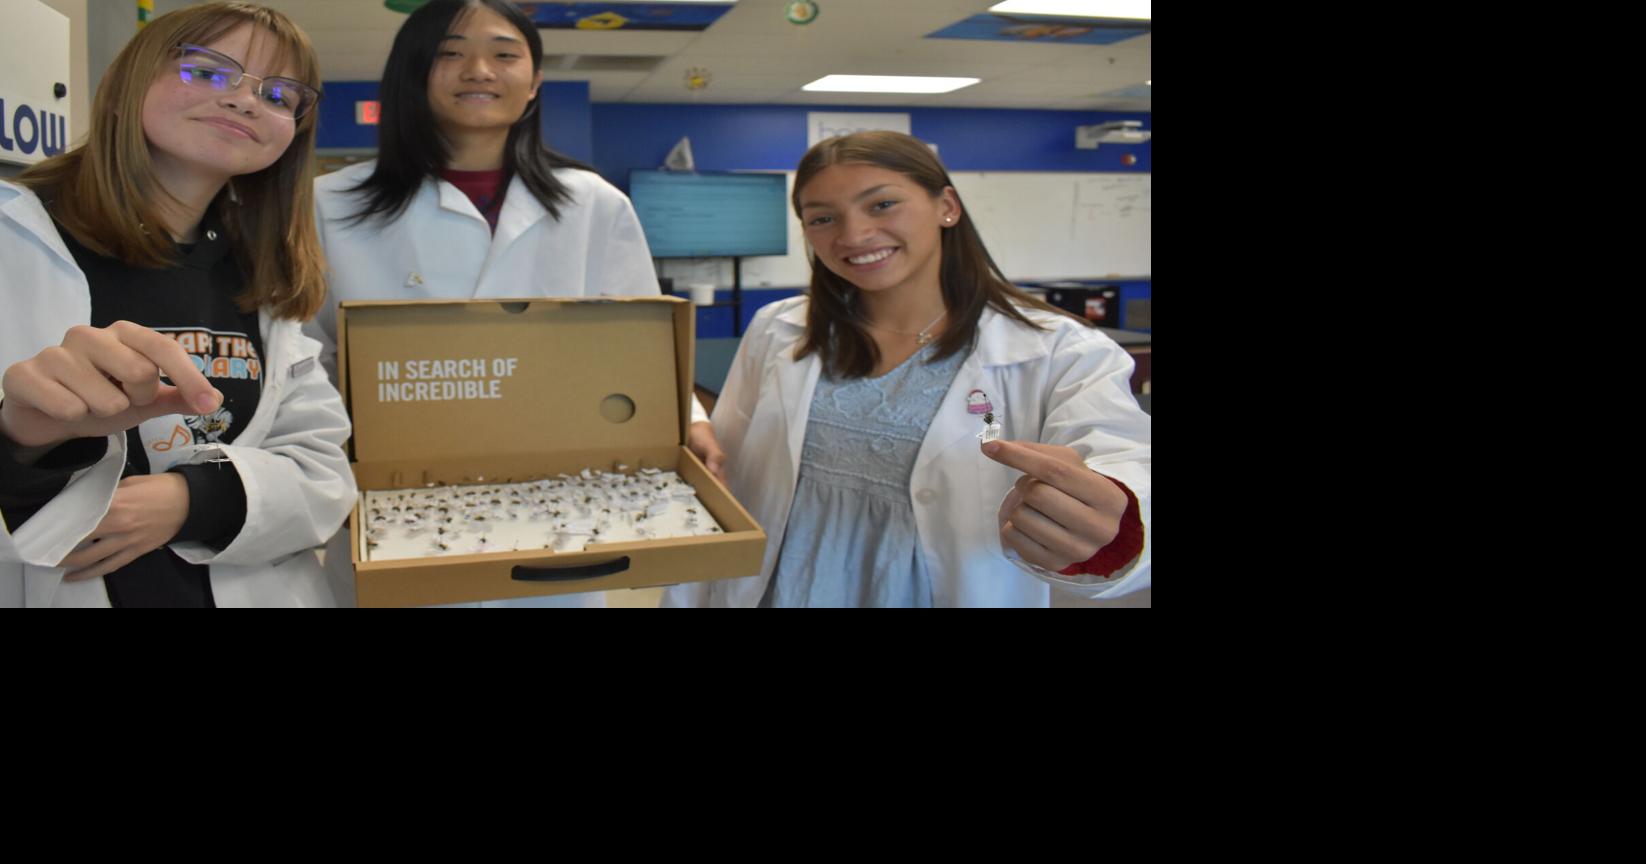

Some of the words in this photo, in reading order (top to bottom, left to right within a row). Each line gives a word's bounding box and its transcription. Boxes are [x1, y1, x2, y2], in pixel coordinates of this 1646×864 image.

[378, 361, 399, 380] IN
[405, 358, 487, 379] SEARCH
[492, 357, 519, 377] OF
[378, 380, 502, 402] INCREDIBLE
